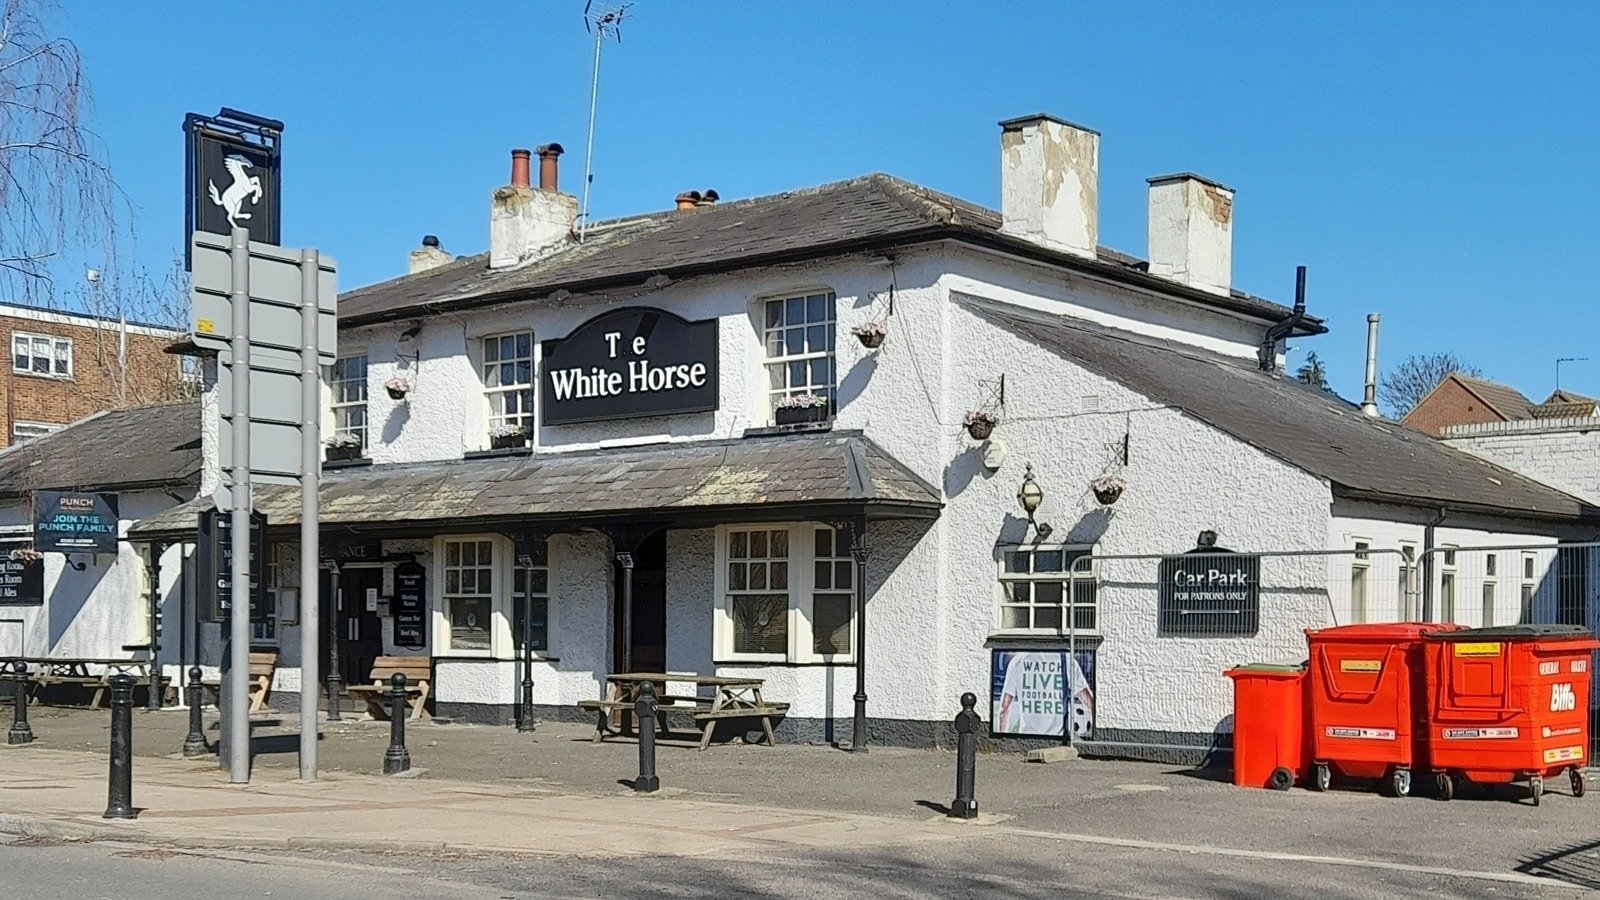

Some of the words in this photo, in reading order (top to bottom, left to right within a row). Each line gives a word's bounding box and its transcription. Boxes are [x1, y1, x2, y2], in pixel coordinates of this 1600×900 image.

[550, 367, 622, 400] White
[628, 360, 706, 393] Horse
[60, 498, 93, 506] PUNCH
[53, 515, 77, 523] JOIN
[80, 515, 99, 524] THE
[38, 523, 74, 531] PUNCH
[76, 524, 114, 533] FAMILY
[1174, 569, 1204, 587] Car
[1208, 569, 1247, 587] Park
[1174, 592, 1189, 600] FOR
[1190, 592, 1224, 600] PATRONS
[1226, 592, 1247, 600] ONLY
[1023, 661, 1062, 672] WATCH
[1022, 673, 1063, 690] LIVE
[1021, 691, 1063, 699] FOOTBALL
[1022, 700, 1063, 715] HERE
